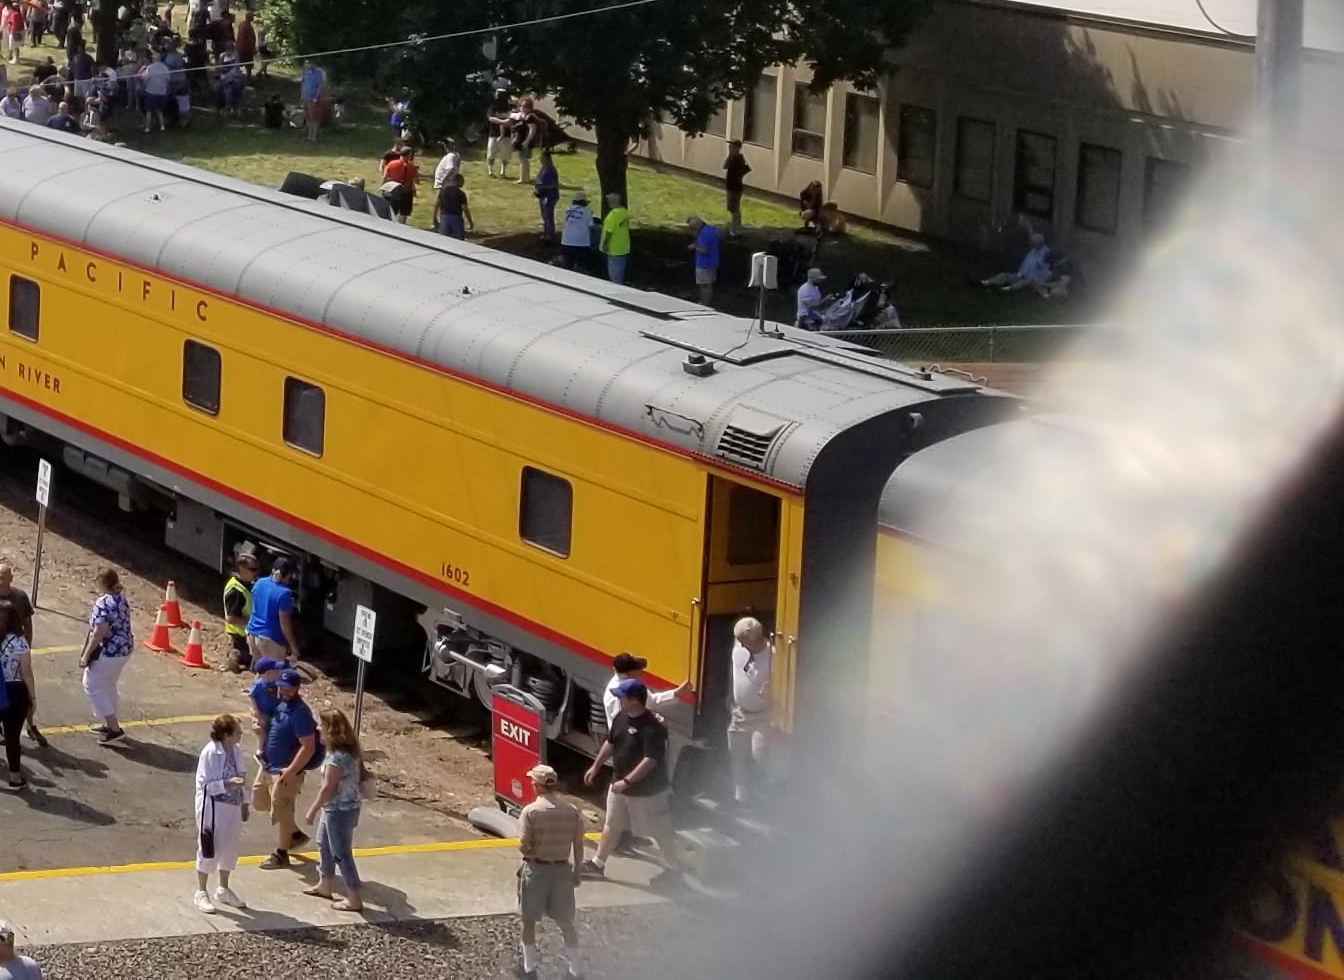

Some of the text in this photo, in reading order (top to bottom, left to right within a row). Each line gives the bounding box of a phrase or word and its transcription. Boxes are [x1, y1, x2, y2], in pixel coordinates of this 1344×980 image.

[30, 241, 209, 322] PACIFIC
[18, 362, 60, 394] RIVER
[441, 562, 470, 587] 1602
[500, 718, 531, 747] EXIT
